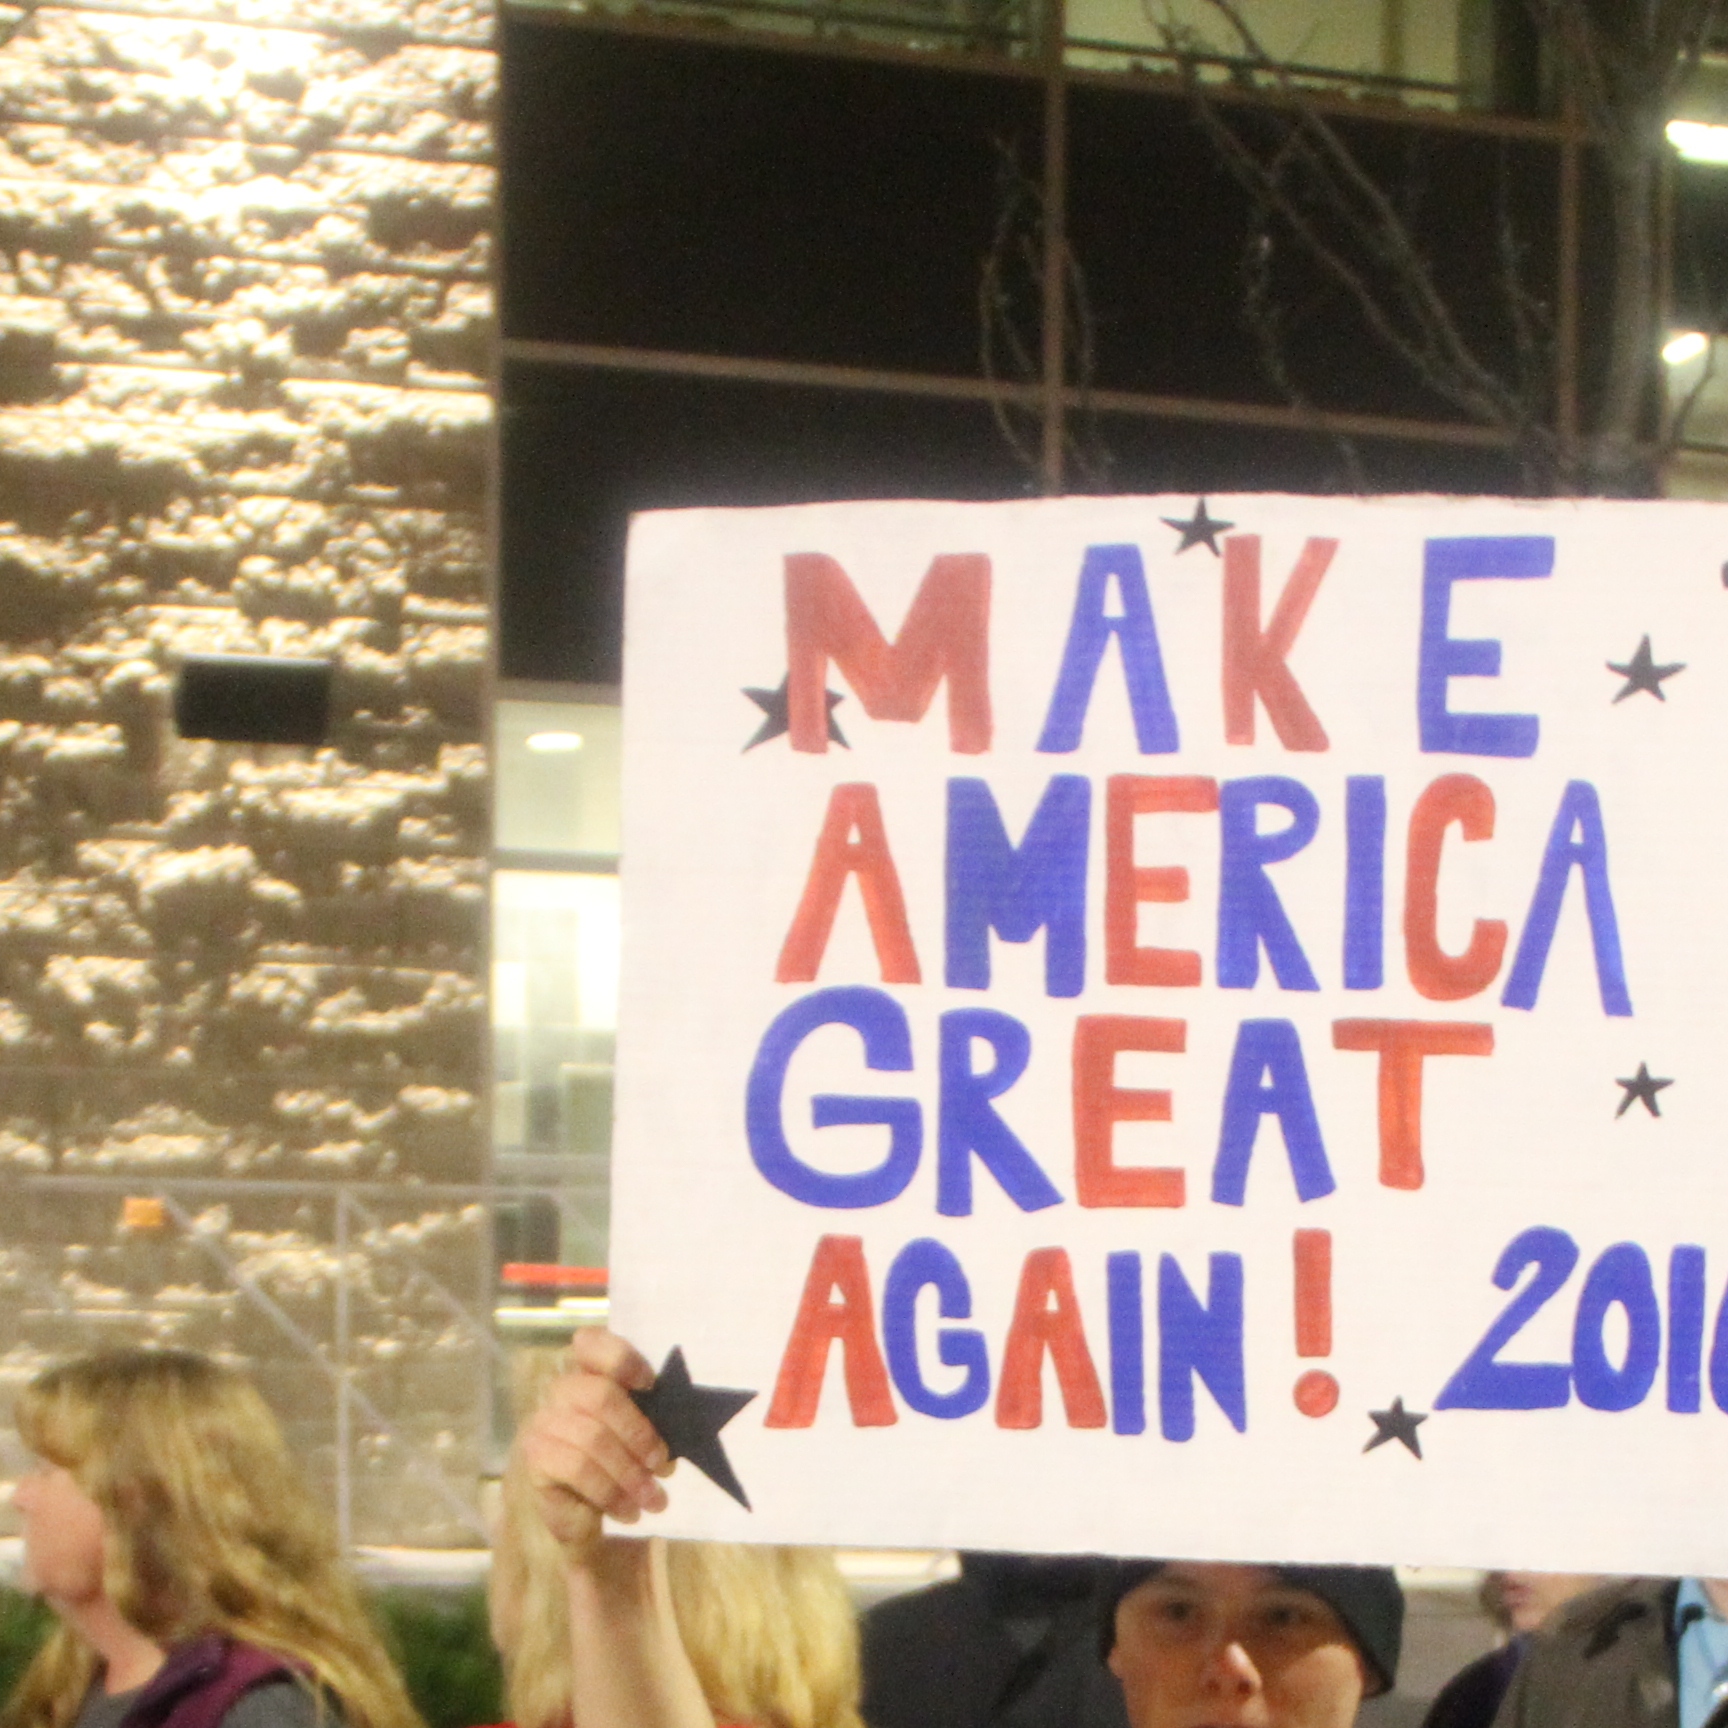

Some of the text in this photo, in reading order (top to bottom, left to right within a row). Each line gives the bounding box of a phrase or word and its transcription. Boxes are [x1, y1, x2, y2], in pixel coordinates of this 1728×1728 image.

[783, 535, 1555, 757] MAKE
[775, 774, 1634, 1017] AMERICA
[745, 986, 1494, 1216] GREAT
[763, 1229, 1340, 1442] AGAIN!
